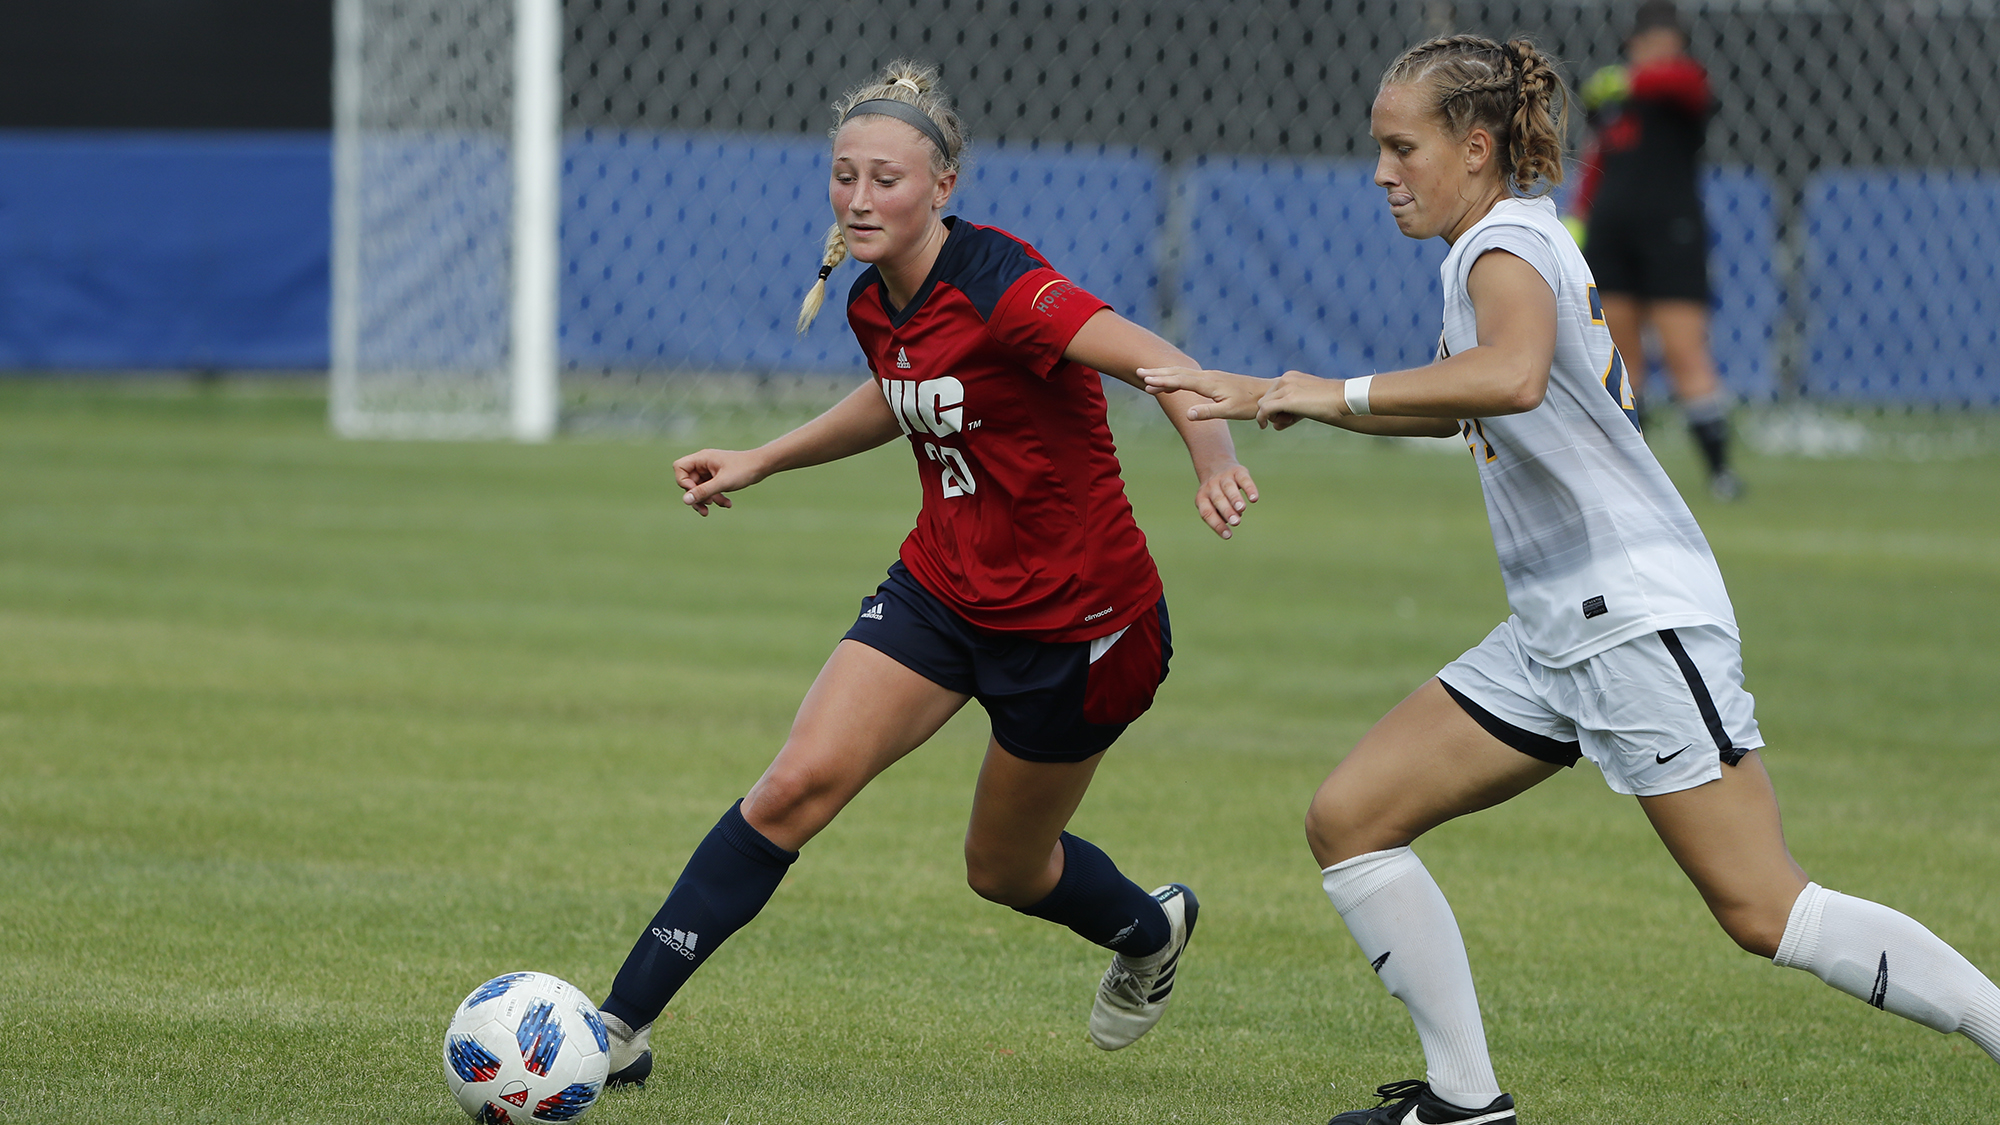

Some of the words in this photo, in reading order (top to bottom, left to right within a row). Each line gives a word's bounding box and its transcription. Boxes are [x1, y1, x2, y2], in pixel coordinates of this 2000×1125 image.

[1036, 282, 1076, 313] HORIZ
[924, 441, 977, 499] 20
[1084, 605, 1114, 622] climacool
[651, 926, 696, 961] adidas
